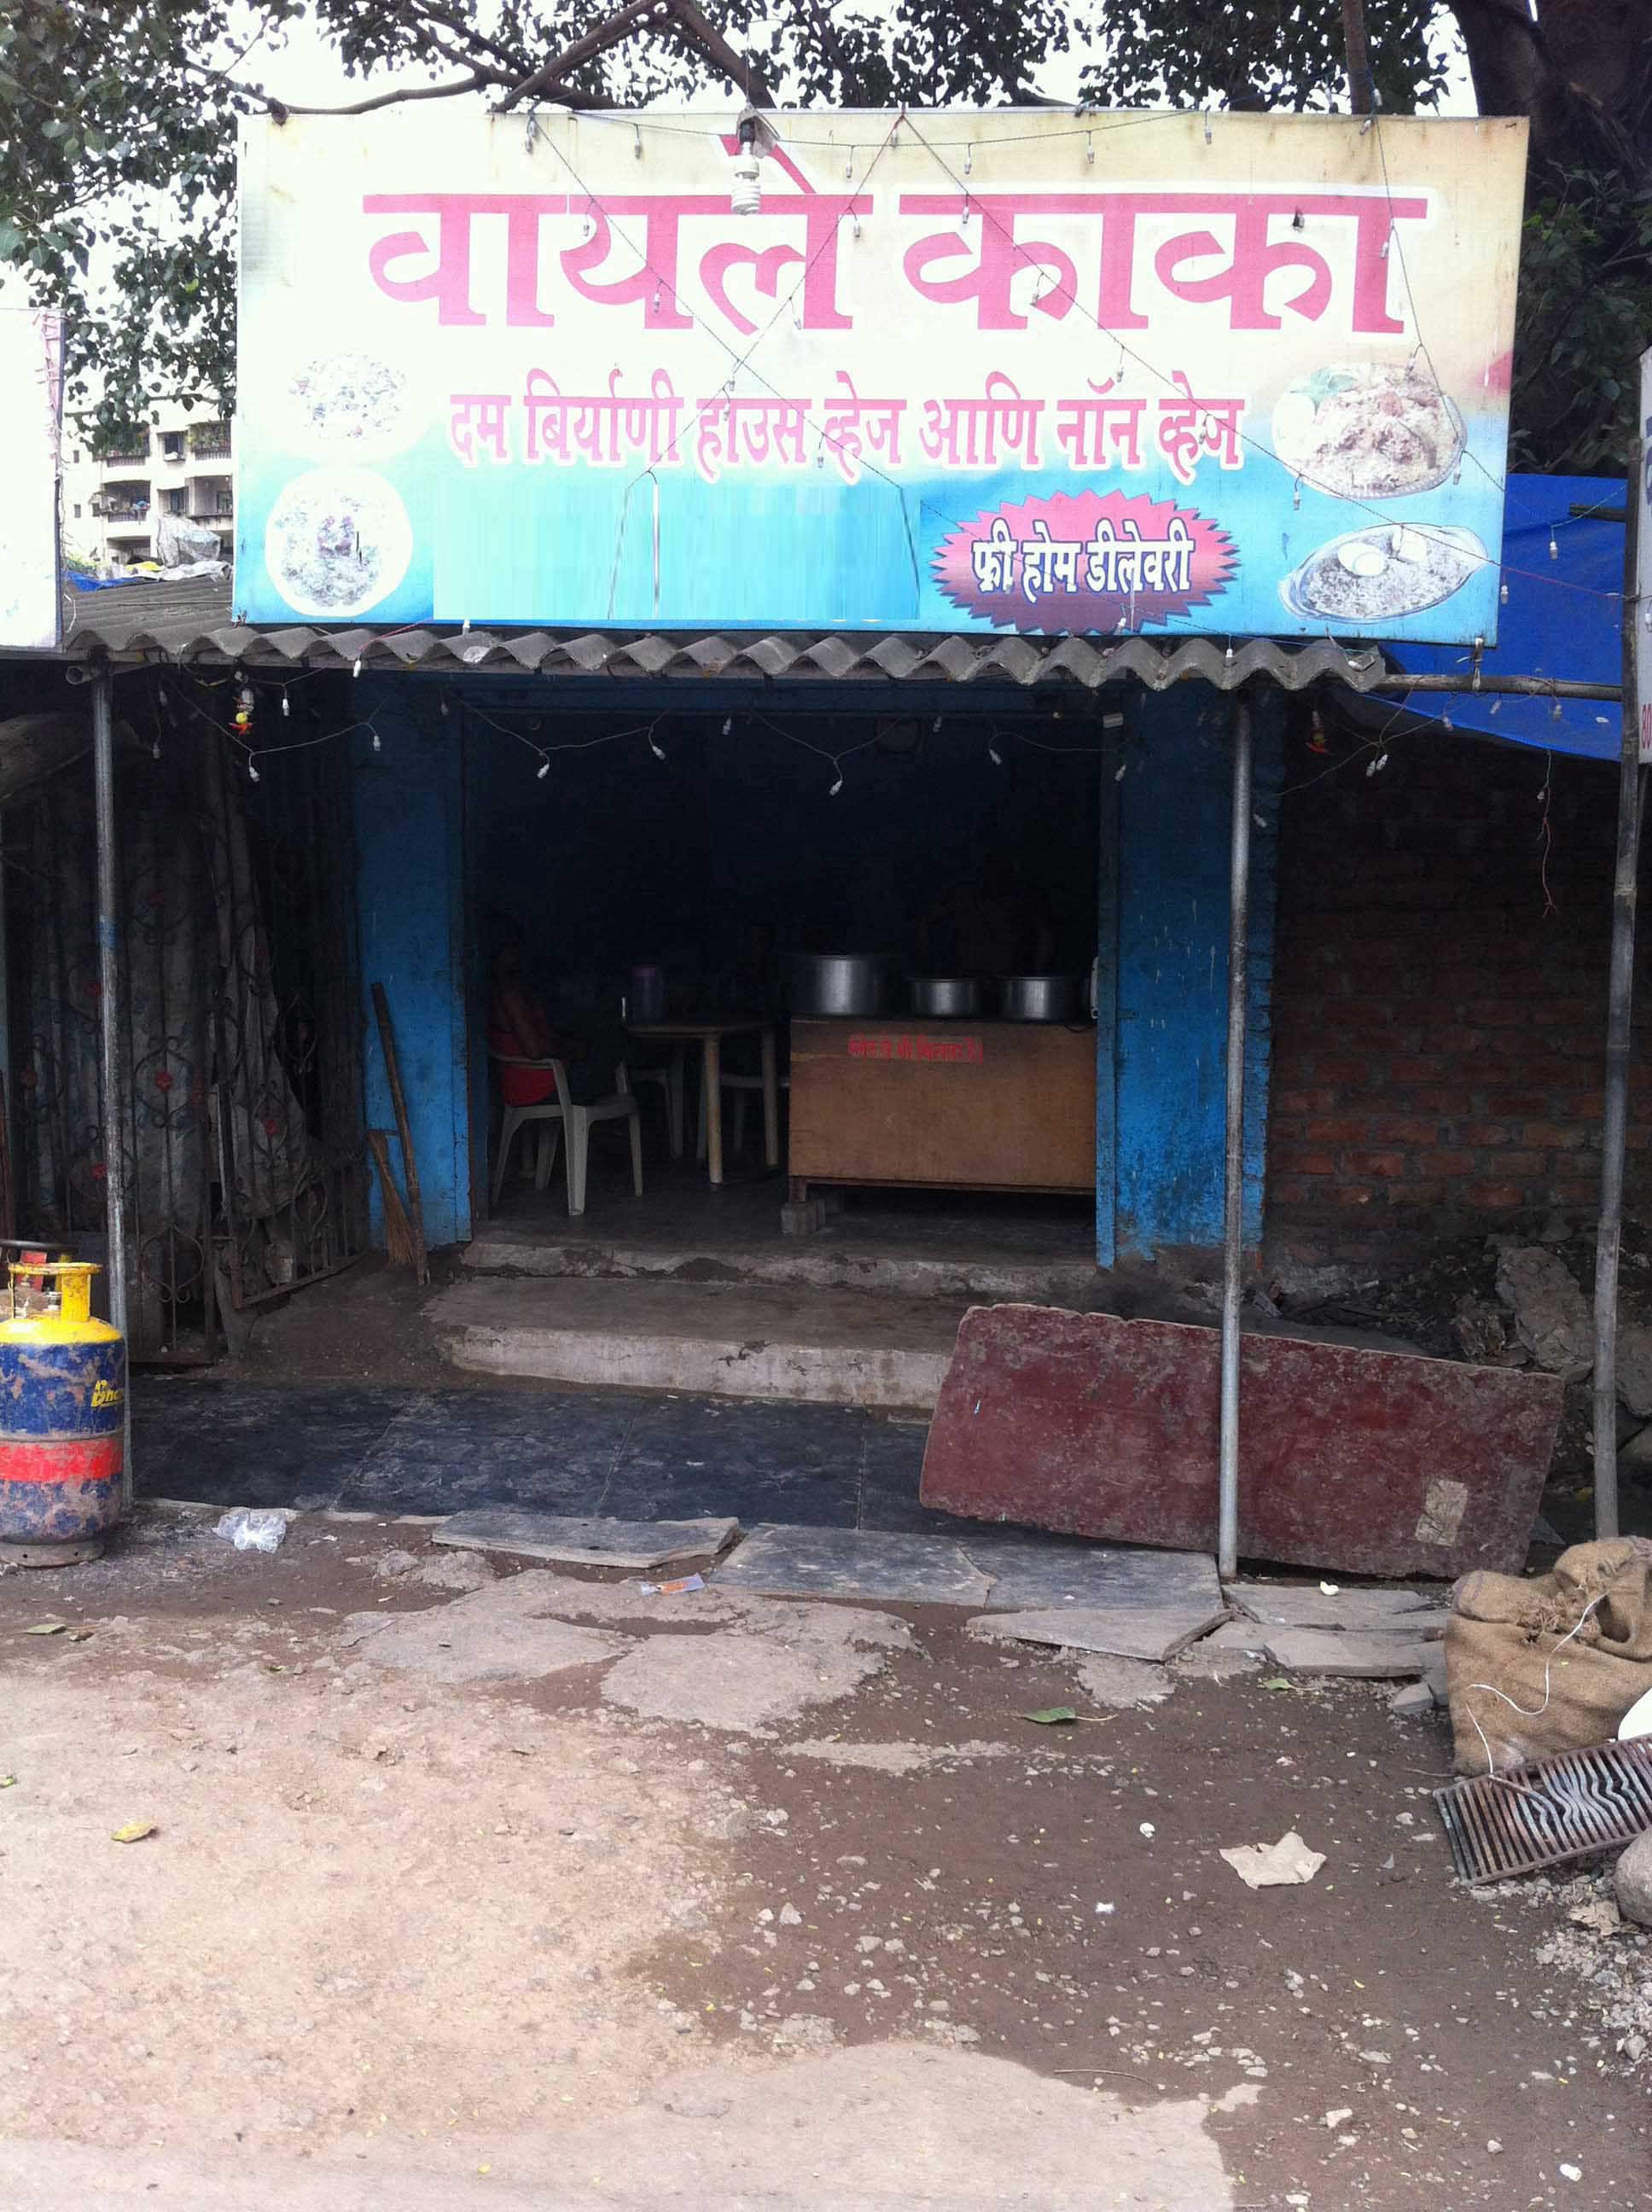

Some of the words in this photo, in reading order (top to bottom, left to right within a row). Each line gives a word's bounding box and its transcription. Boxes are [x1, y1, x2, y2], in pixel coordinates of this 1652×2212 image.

[363, 134, 874, 335] वायले
[899, 193, 1428, 334] काका
[450, 394, 512, 462] दम
[523, 368, 684, 462] बिर्याणी
[695, 399, 812, 479] हाउस
[824, 370, 907, 478] व्हेज
[919, 370, 1045, 464] आणि
[1056, 376, 1147, 465] नॉन
[1158, 370, 1246, 479] व्हेज
[972, 518, 1017, 591] फ्री
[1023, 519, 1082, 603] होम
[1085, 518, 1195, 593] डीलेवरी
